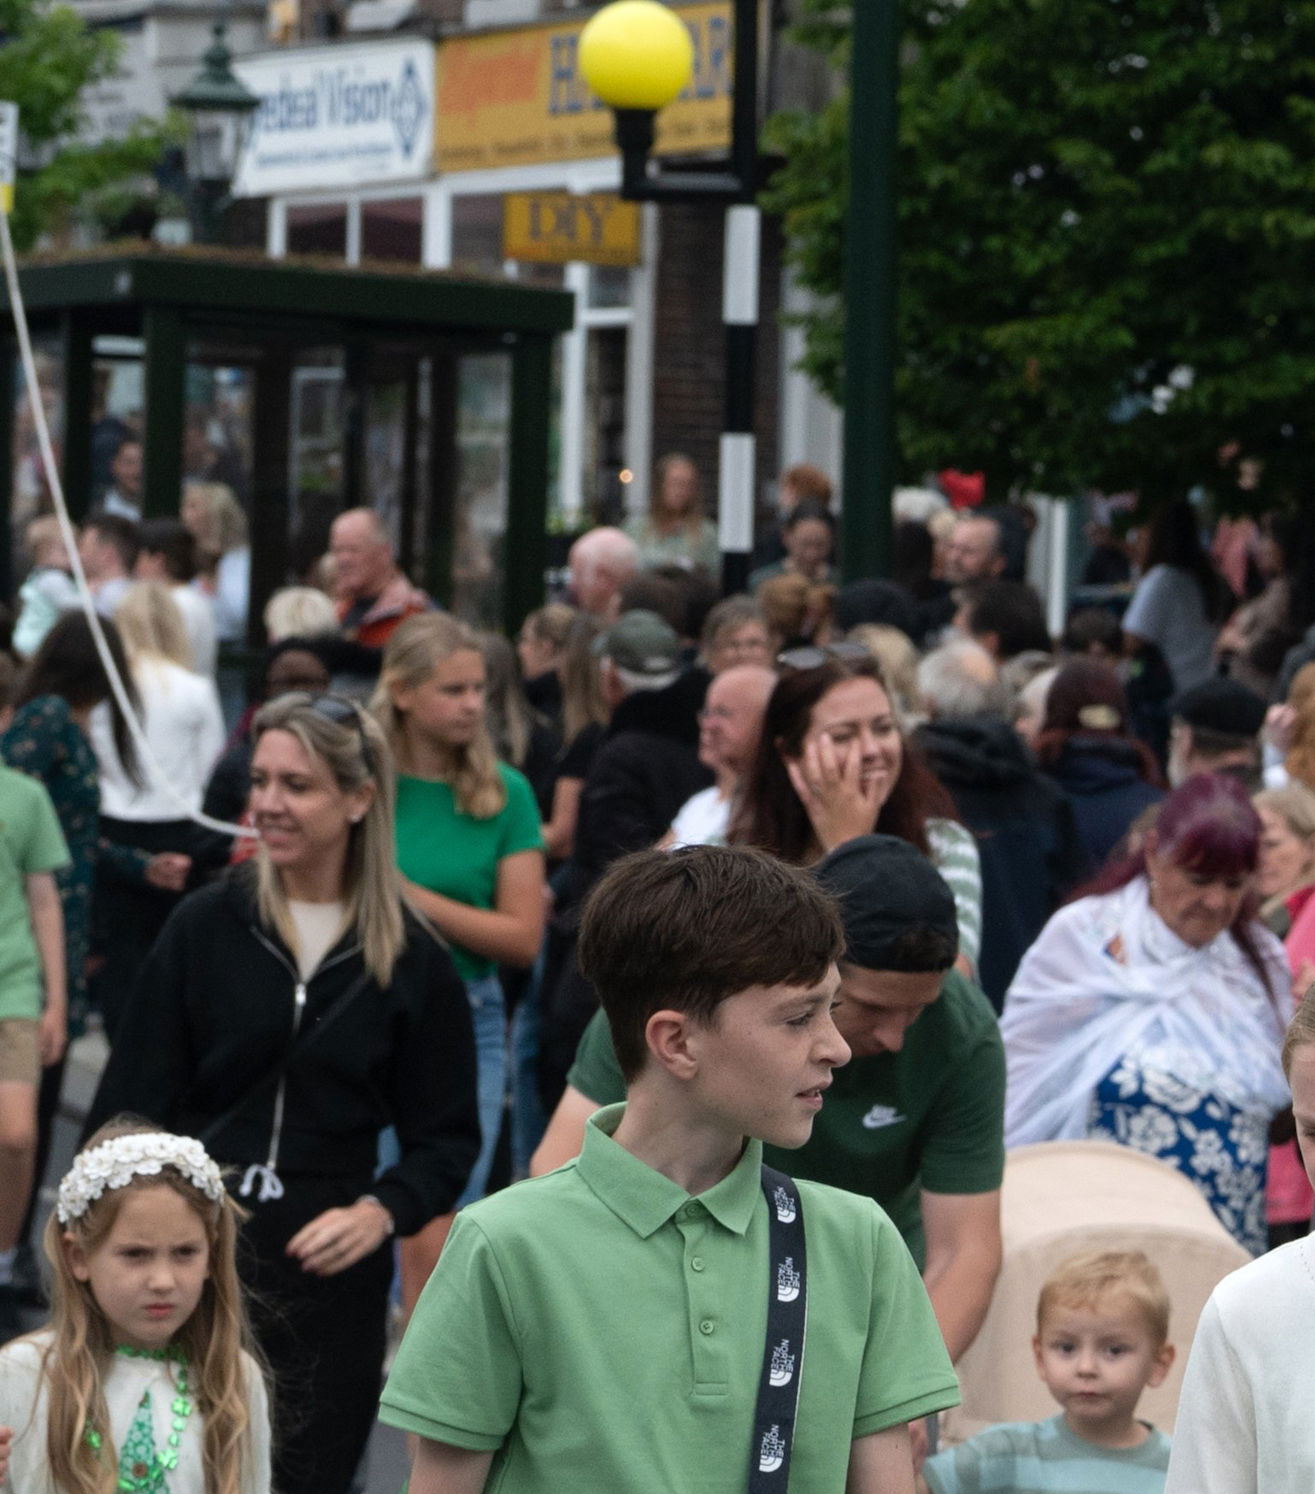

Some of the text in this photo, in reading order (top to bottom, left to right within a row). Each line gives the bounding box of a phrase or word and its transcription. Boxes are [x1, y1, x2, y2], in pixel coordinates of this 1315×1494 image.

[528, 197, 615, 245] DIY
[777, 1263, 786, 1287] FACE
[784, 1256, 793, 1288] NORTH
[792, 1271, 800, 1288] THE
[770, 1346, 780, 1371] FACE
[779, 1338, 789, 1372] NORTH
[786, 1354, 795, 1373] THE
[760, 1432, 770, 1456] FACE
[766, 1424, 779, 1458] NORTH
[775, 1439, 785, 1458] THE
